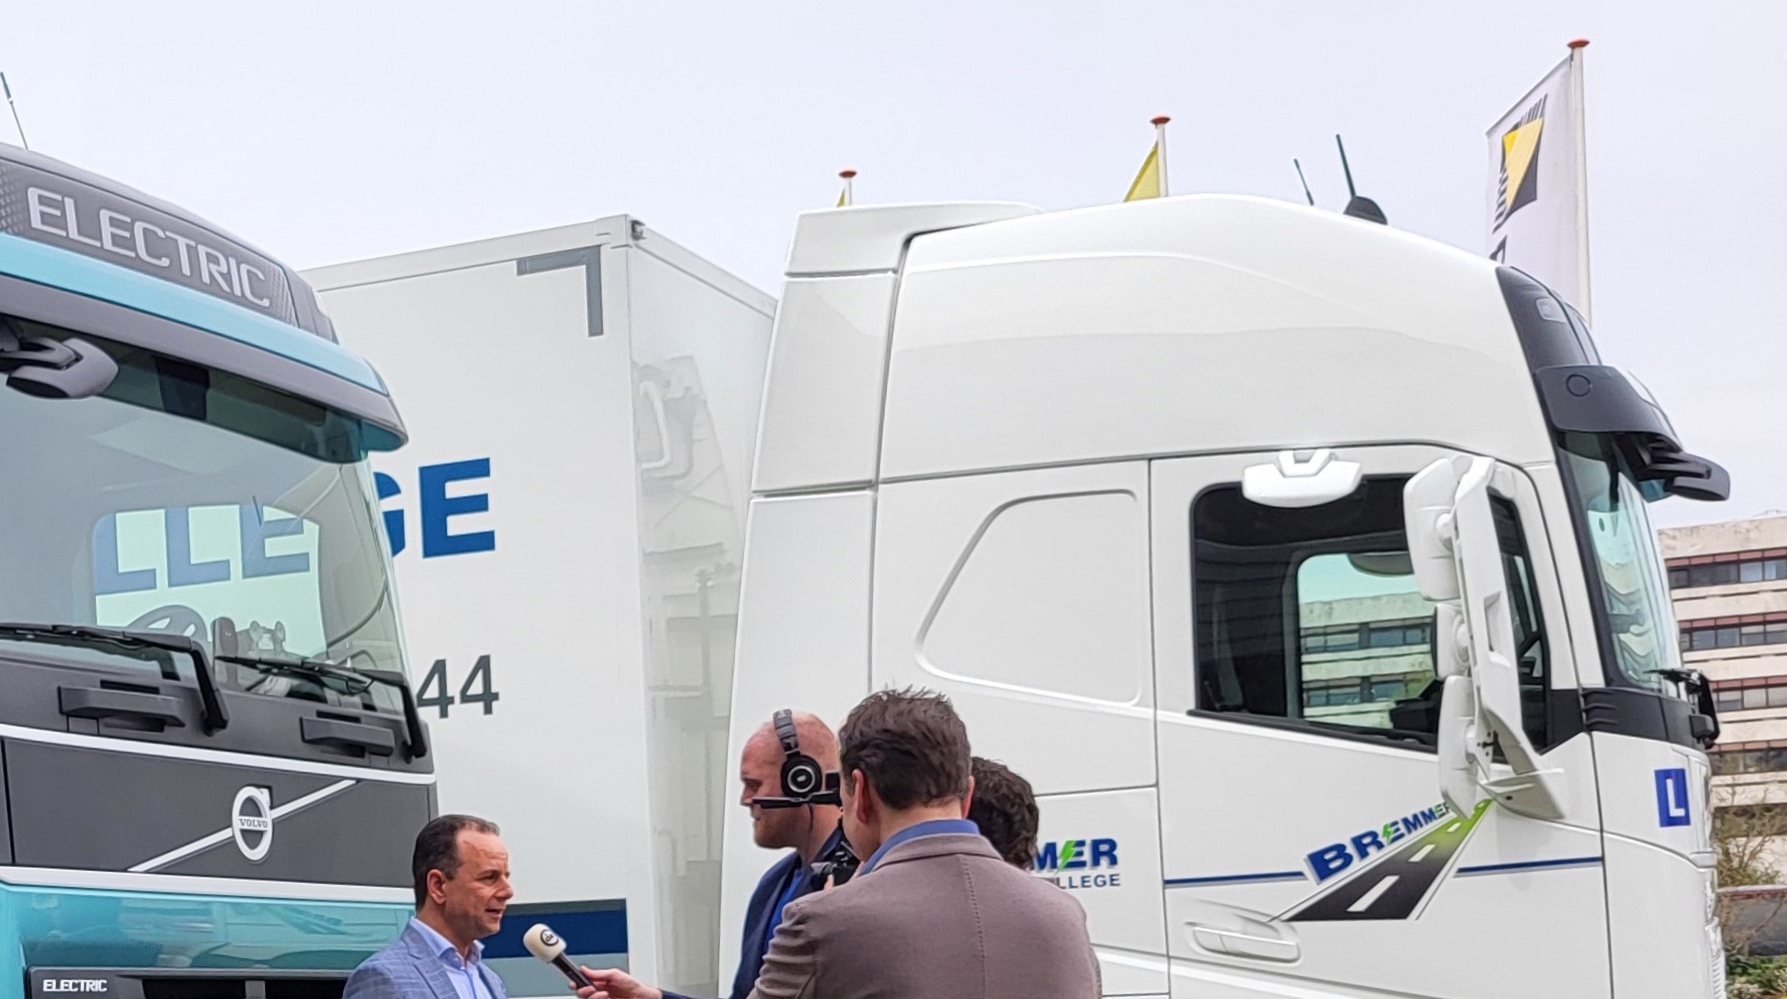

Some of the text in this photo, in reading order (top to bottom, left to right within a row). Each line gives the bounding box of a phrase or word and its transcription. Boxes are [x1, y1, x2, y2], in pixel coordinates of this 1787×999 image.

[27, 186, 271, 307] ELECTRIC
[416, 654, 500, 719] 44
[1666, 778, 1686, 817] L
[239, 818, 268, 829] VOLVO
[1045, 873, 1121, 890] LLEGE
[42, 979, 108, 992] ELECTRIC
